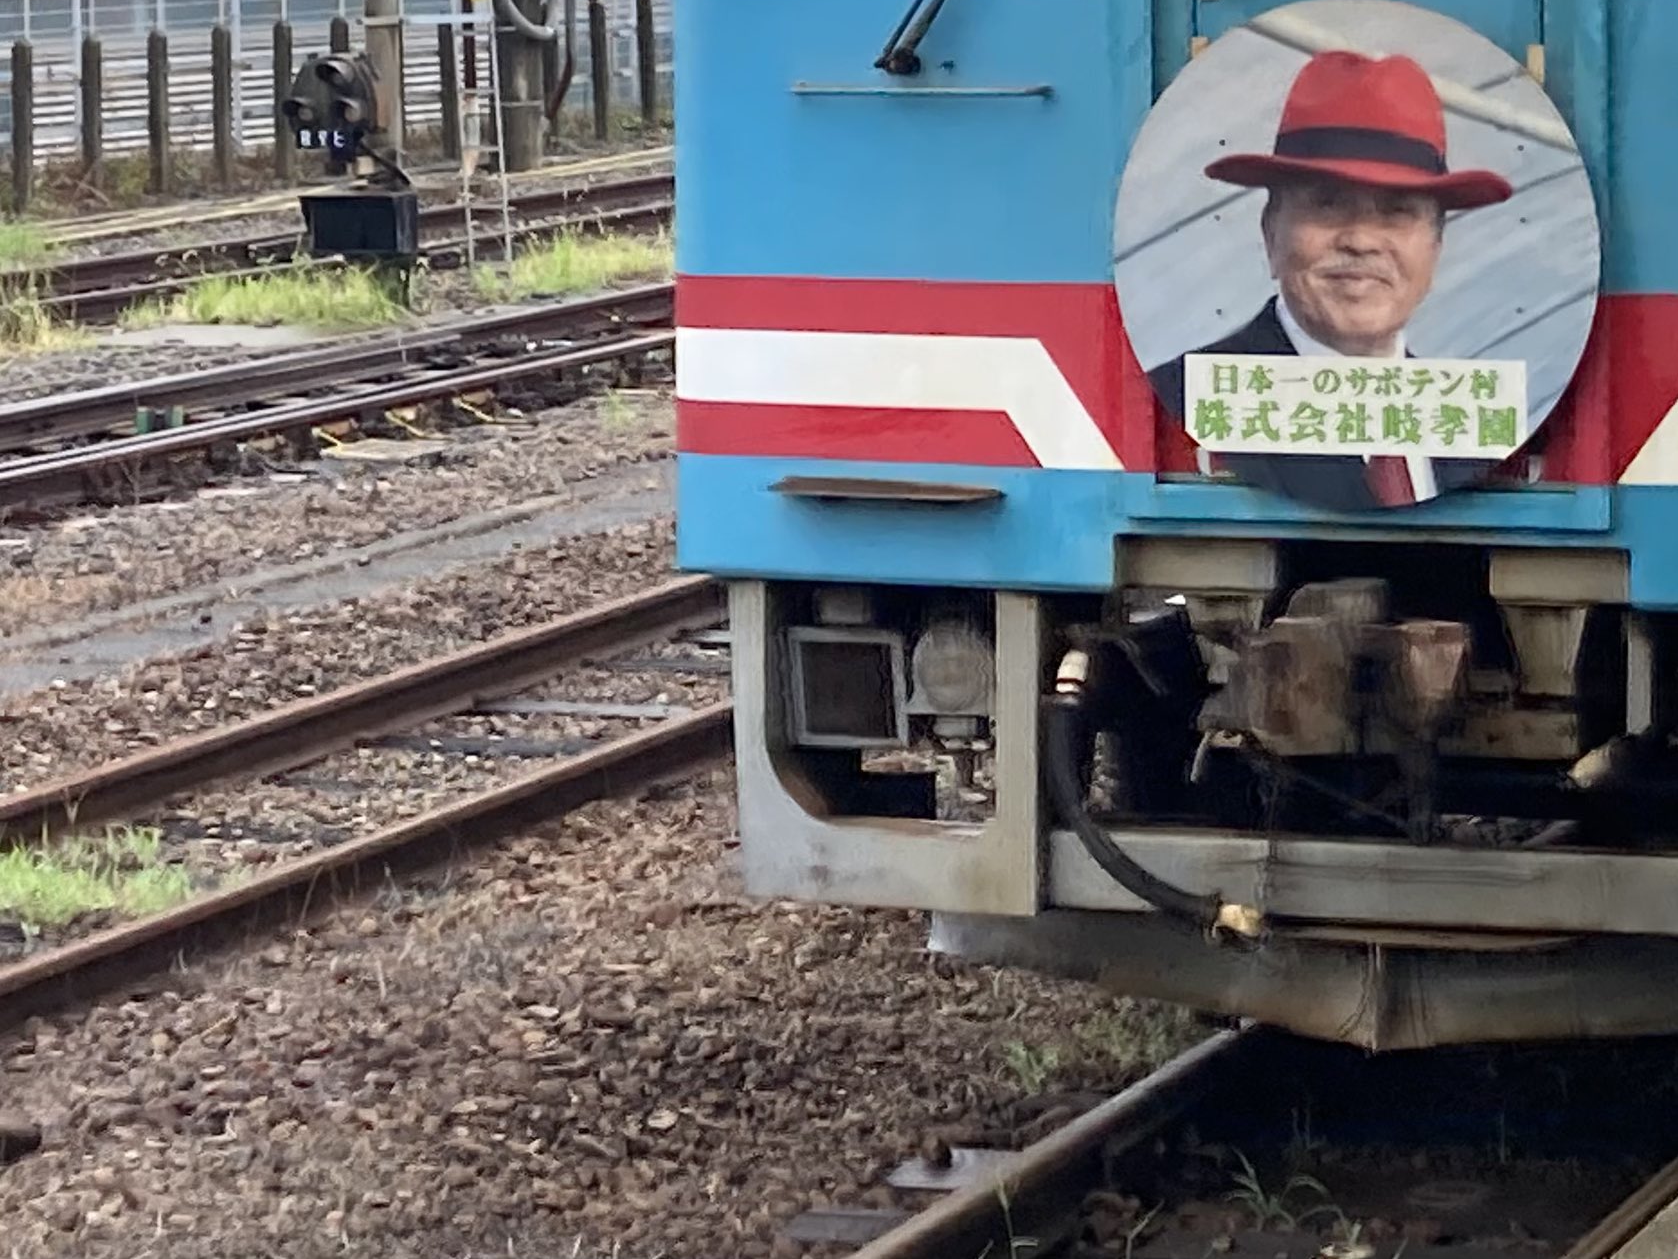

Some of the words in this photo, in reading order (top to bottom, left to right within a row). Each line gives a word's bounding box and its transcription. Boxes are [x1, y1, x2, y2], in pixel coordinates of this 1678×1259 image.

[1213, 363, 1498, 400] 日本一のサボテン村
[1194, 399, 1517, 448] 株式会社岐孝園
